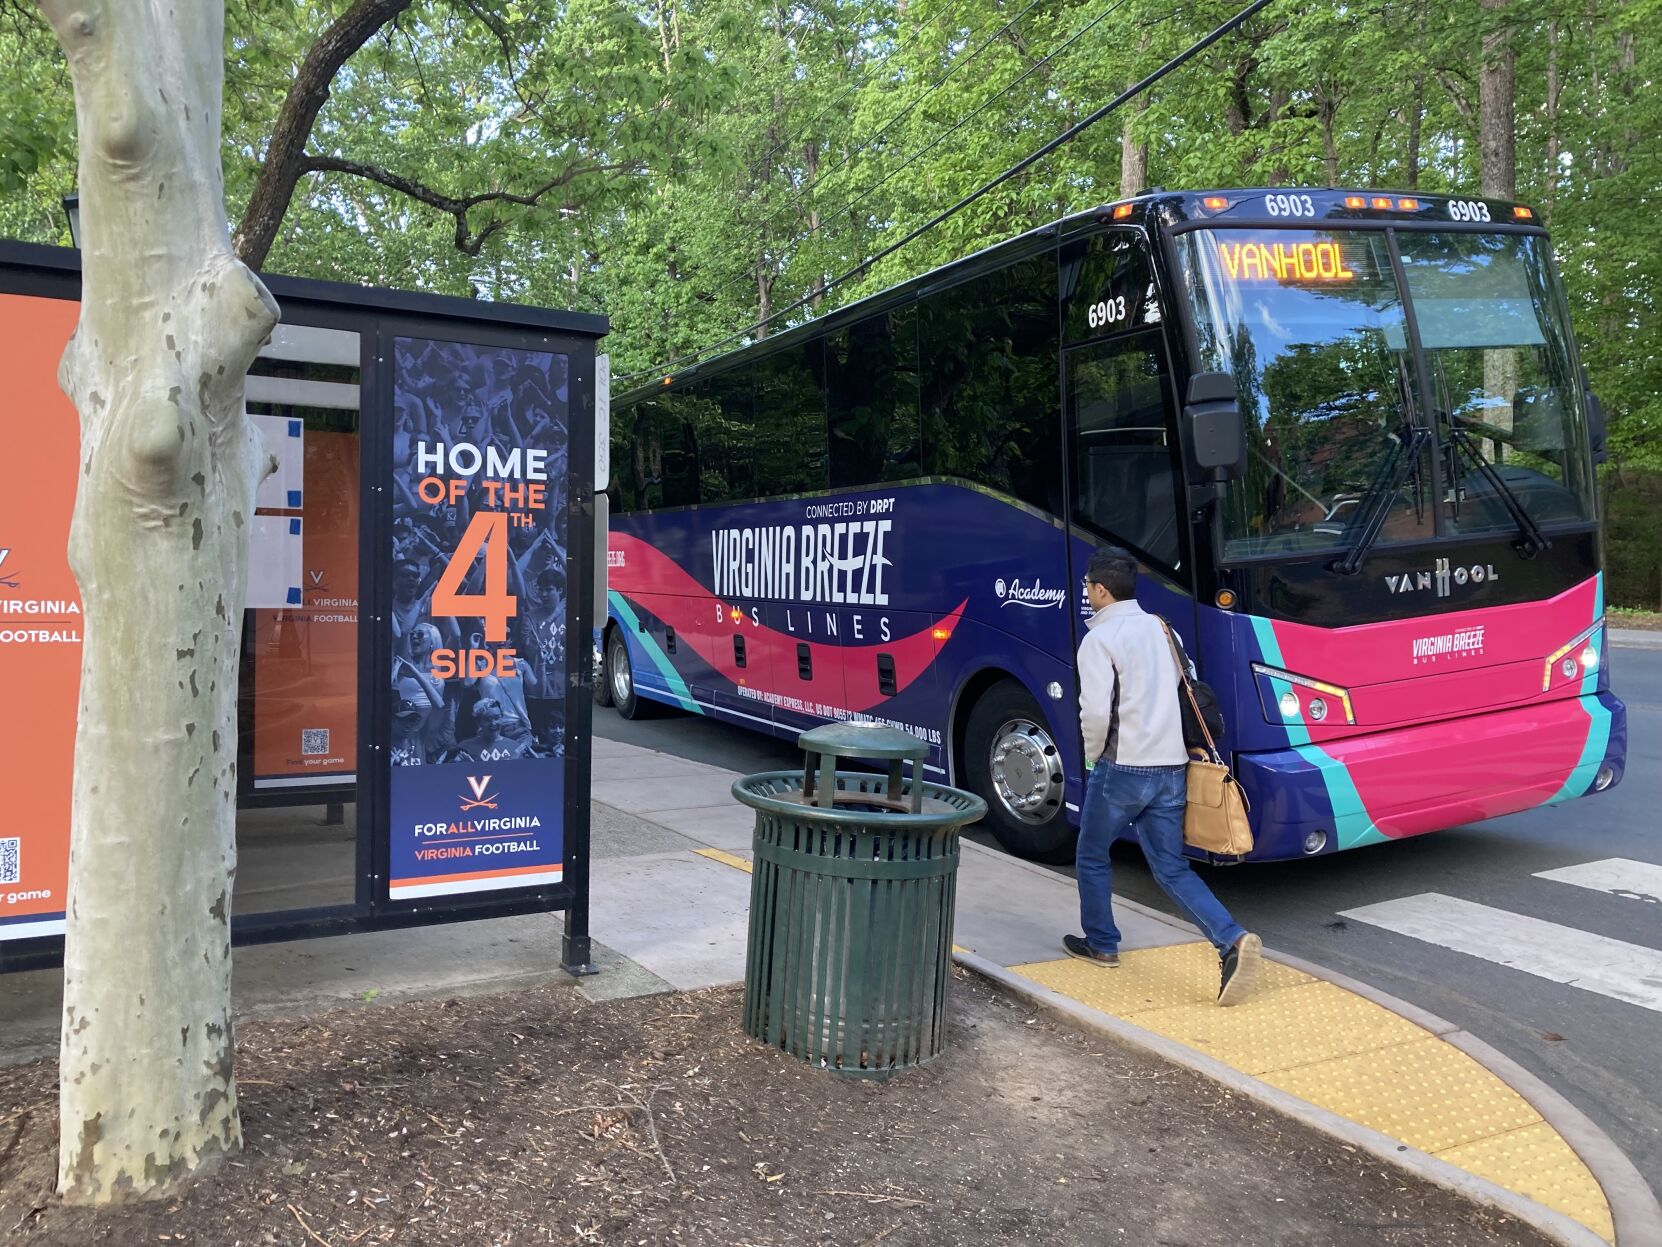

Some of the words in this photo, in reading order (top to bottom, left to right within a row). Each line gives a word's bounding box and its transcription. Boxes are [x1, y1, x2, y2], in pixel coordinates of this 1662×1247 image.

[1265, 194, 1315, 217] 6903
[1448, 200, 1492, 222] 6903
[1220, 243, 1353, 279] VANHOOL
[1088, 295, 1126, 328] 6903
[417, 441, 547, 480] HOME
[418, 476, 467, 504] OF
[482, 480, 545, 509] THE
[806, 502, 854, 519] CONNECTED
[856, 500, 869, 515] BY
[870, 498, 895, 514] DRPT
[712, 525, 796, 599] VIRGINIA
[800, 519, 893, 606] BREEZE
[0, 600, 81, 614] IRGINIA
[1008, 578, 1066, 609] Academy
[313, 615, 358, 623] FOOTBALL
[716, 604, 759, 627] BUS
[787, 609, 891, 642] LINES
[1413, 634, 1452, 657] VIRGINIA
[1453, 630, 1485, 651] BREEZE
[1413, 656, 1436, 665] BUS
[1447, 648, 1484, 660] LINES
[431, 648, 517, 680] SIDE
[737, 685, 757, 699] OPERATED
[764, 692, 783, 706] ACADEMY
[815, 703, 823, 715] US
[823, 705, 833, 718] DOT
[928, 729, 941, 744] LBS
[322, 758, 345, 766] game
[415, 846, 473, 861] VIRGINIA
[475, 840, 540, 856] FOOTBALL
[7, 890, 51, 904] game
